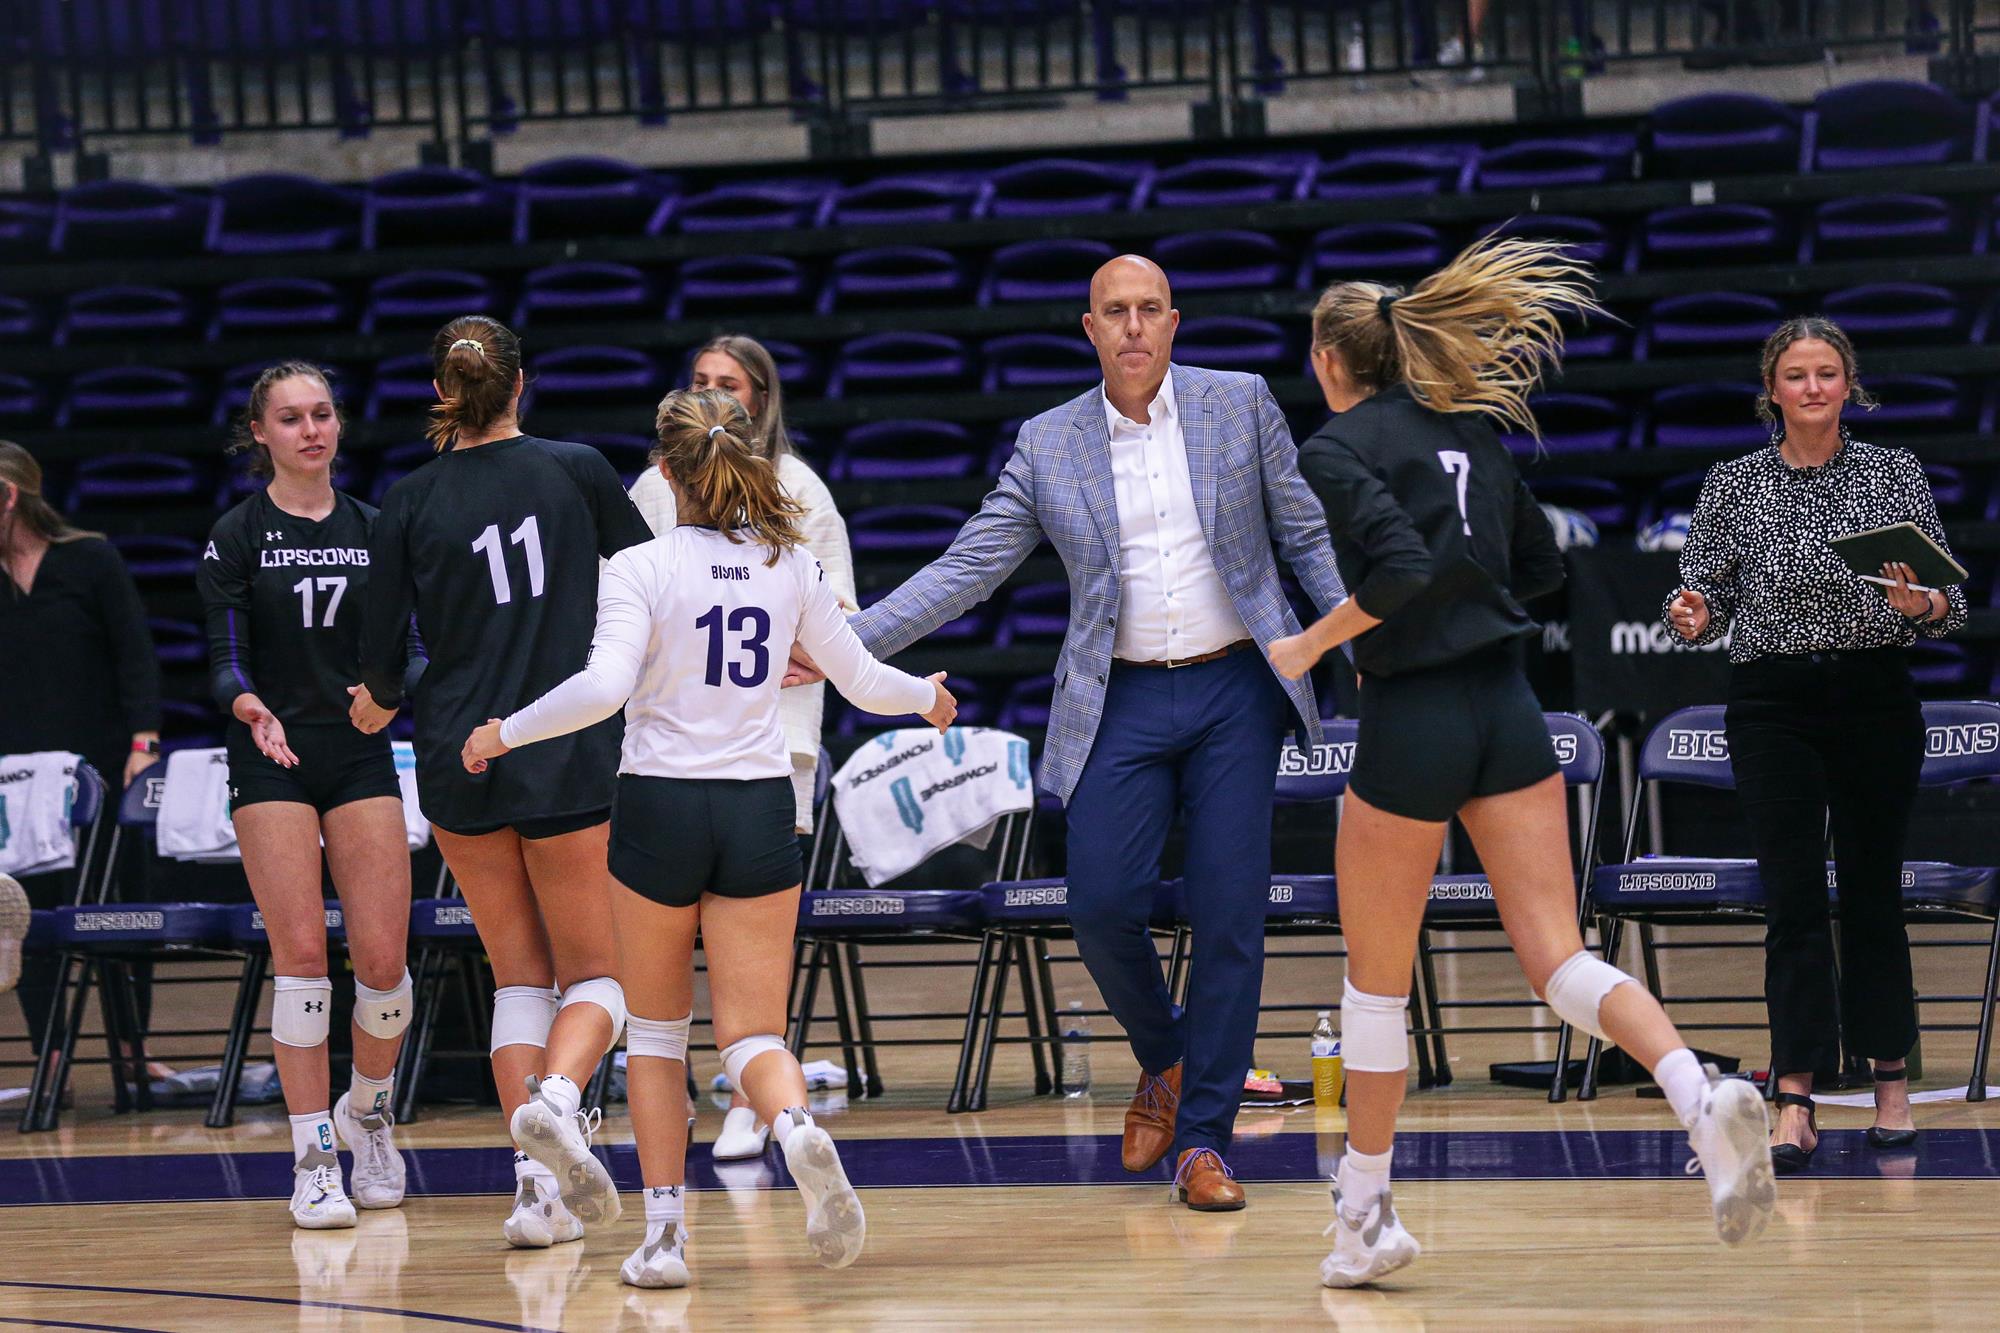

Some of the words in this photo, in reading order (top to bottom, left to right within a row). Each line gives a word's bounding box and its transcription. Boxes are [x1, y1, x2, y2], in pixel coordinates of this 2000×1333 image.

[1438, 450, 1471, 536] 7
[261, 547, 370, 567] LIPSCOMB
[472, 515, 545, 604] 11
[711, 564, 750, 581] BISONS
[294, 576, 348, 628] 17
[695, 605, 771, 687] 13
[1667, 729, 1730, 761] BIS
[1924, 722, 1999, 758] ONS
[1619, 872, 1716, 892] LIPSCOMB
[74, 911, 164, 931] LIPSCOMB
[812, 898, 905, 916] LIPSCOMB
